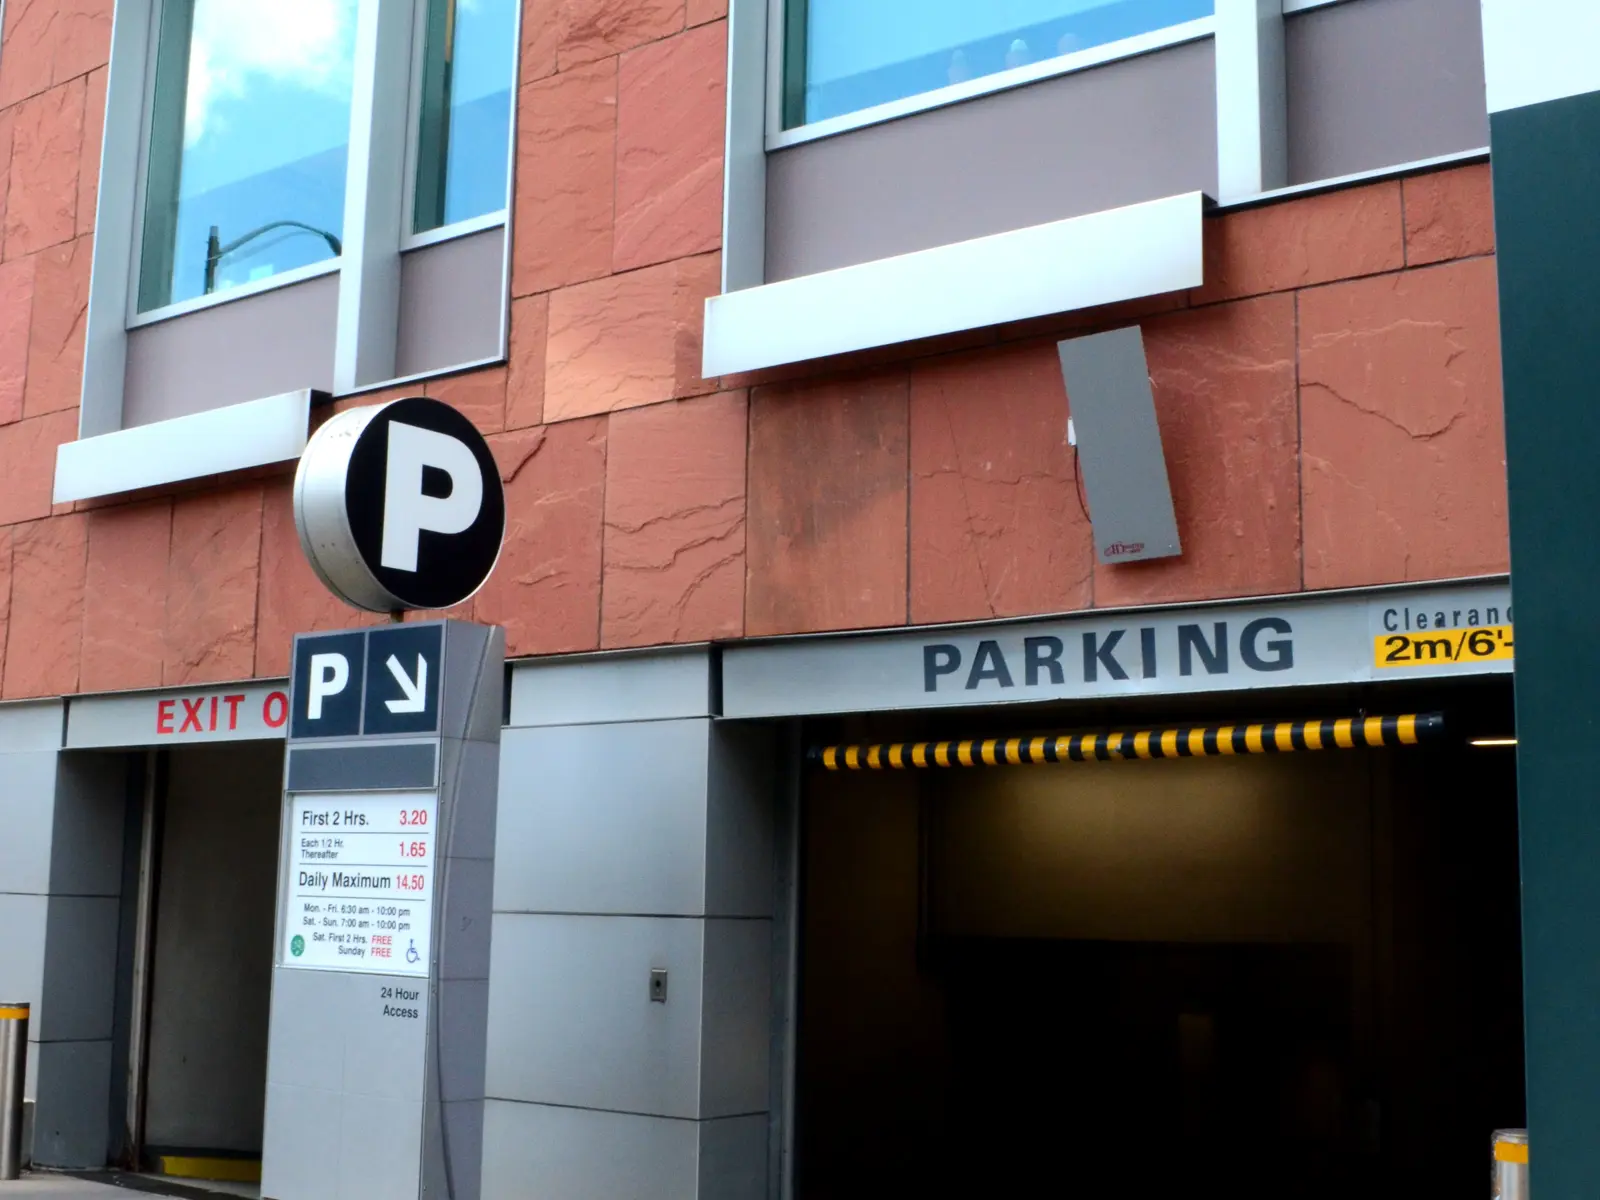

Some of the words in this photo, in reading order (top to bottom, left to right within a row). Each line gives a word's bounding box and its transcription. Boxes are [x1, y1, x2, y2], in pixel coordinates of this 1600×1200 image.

[381, 420, 483, 572] P
[923, 617, 1294, 693] PARKING
[308, 653, 349, 719] P
[157, 695, 245, 734] EXIT
[302, 811, 329, 826] First
[332, 811, 341, 826] 2
[344, 811, 369, 826] Hrs.
[399, 810, 427, 826] 3.20
[301, 838, 319, 848] Each
[399, 841, 426, 857] 1.65
[301, 849, 339, 859] Thereafter
[299, 871, 329, 890] Daily
[332, 872, 391, 889] Maximum
[396, 874, 425, 890] 14.50
[327, 904, 339, 913] Fri.
[341, 904, 357, 914] 6:30
[358, 907, 370, 915] am
[377, 906, 397, 916] 10:00
[398, 909, 411, 918] pm
[303, 916, 317, 926] Sat.
[323, 917, 339, 927] Sun.
[341, 918, 357, 928] 7:00
[358, 921, 370, 929] am
[377, 920, 397, 930] 10:00
[398, 923, 411, 932] pm
[313, 931, 326, 942] Sat.
[328, 932, 345, 943] First
[346, 934, 352, 943] 2
[353, 934, 368, 944] Hrs.
[371, 935, 393, 946] FREE
[338, 945, 366, 958] Sunday
[370, 947, 392, 958] FREE
[381, 986, 393, 999] 24
[395, 987, 420, 1001] Hour
[382, 1004, 419, 1019] Access
